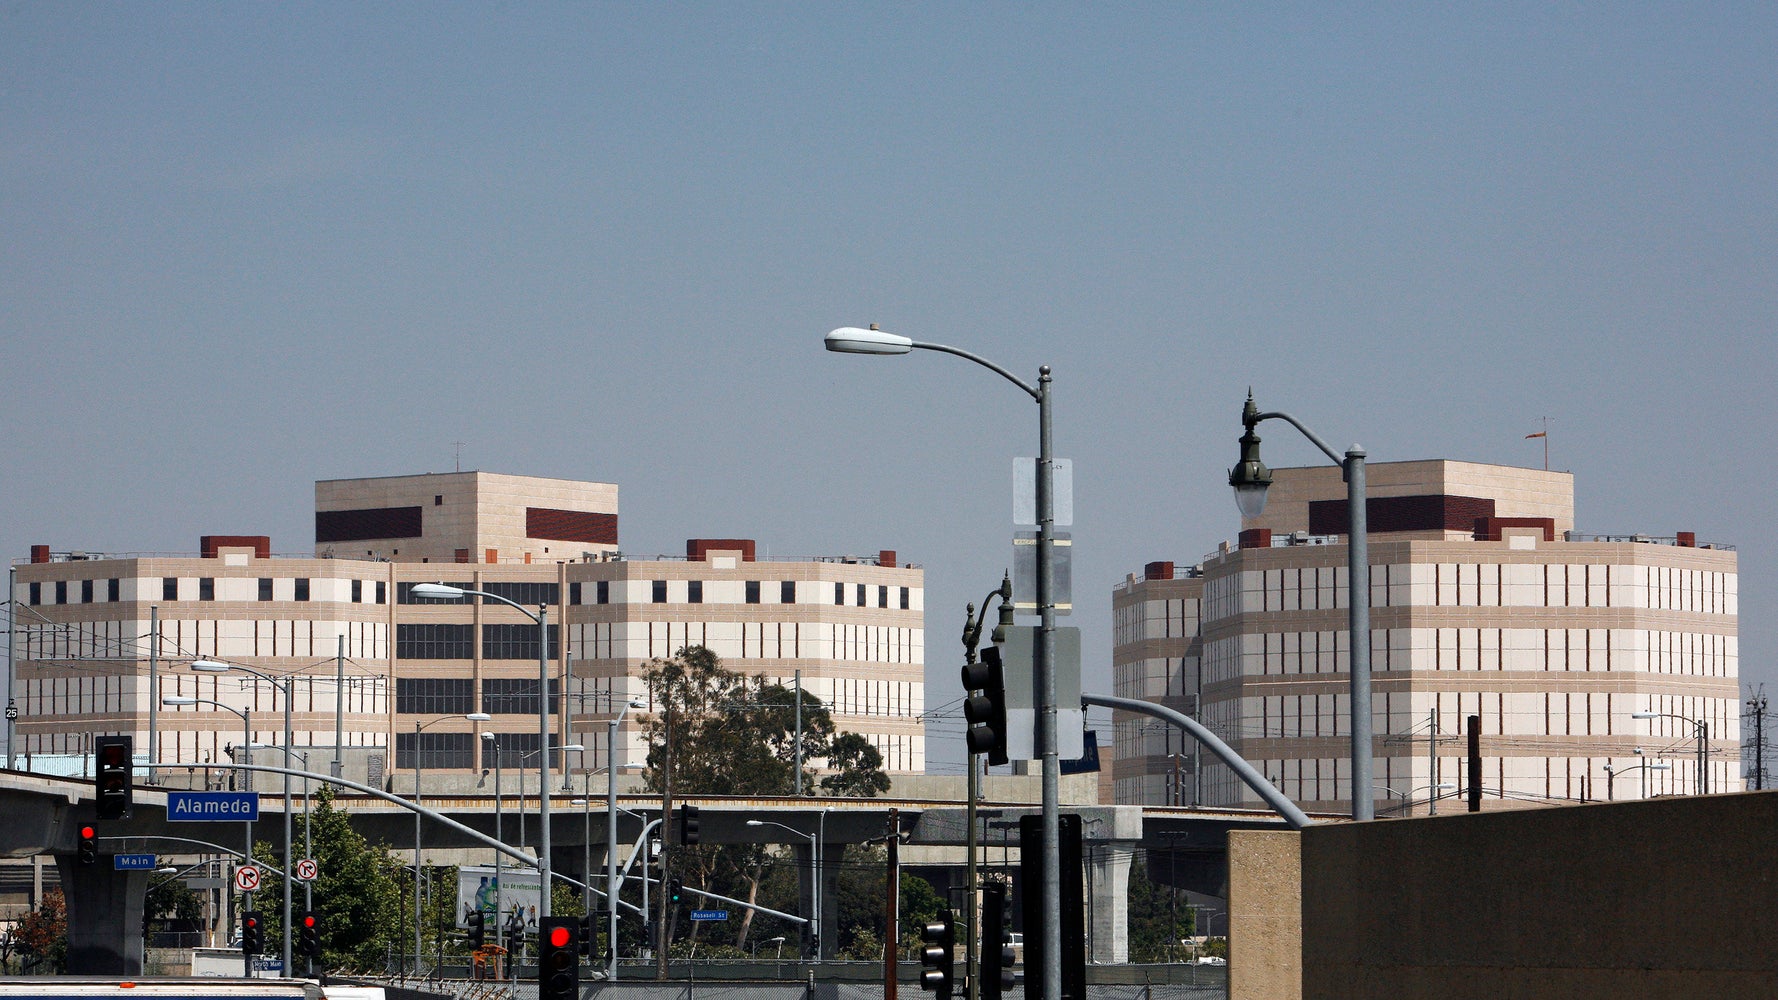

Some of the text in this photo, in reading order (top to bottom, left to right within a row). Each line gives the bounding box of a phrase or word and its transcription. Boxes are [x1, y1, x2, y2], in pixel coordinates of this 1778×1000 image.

[6, 708, 17, 718] 25
[175, 798, 251, 813] Alameda
[121, 857, 148, 865] Main
